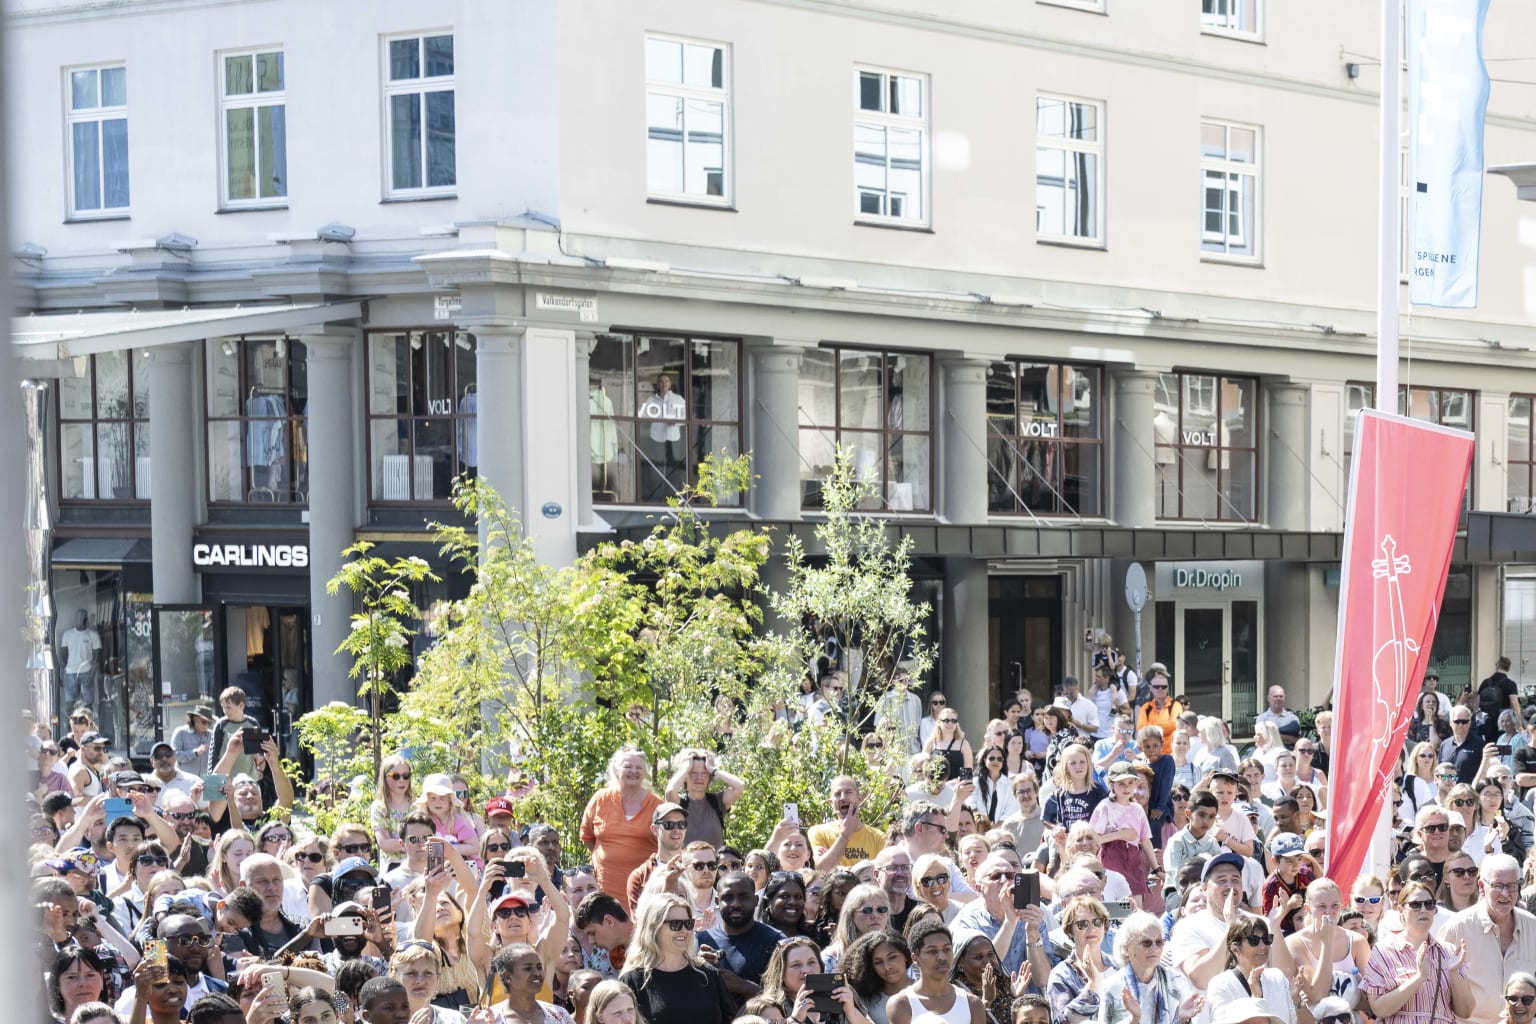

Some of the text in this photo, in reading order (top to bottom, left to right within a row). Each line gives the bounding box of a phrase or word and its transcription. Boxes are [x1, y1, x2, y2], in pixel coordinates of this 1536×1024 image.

[428, 398, 451, 415] VOLT
[638, 402, 686, 419] VOLT
[1020, 421, 1057, 438] VOLT
[1183, 431, 1215, 446] VOLT
[193, 543, 308, 567] CARLINGS
